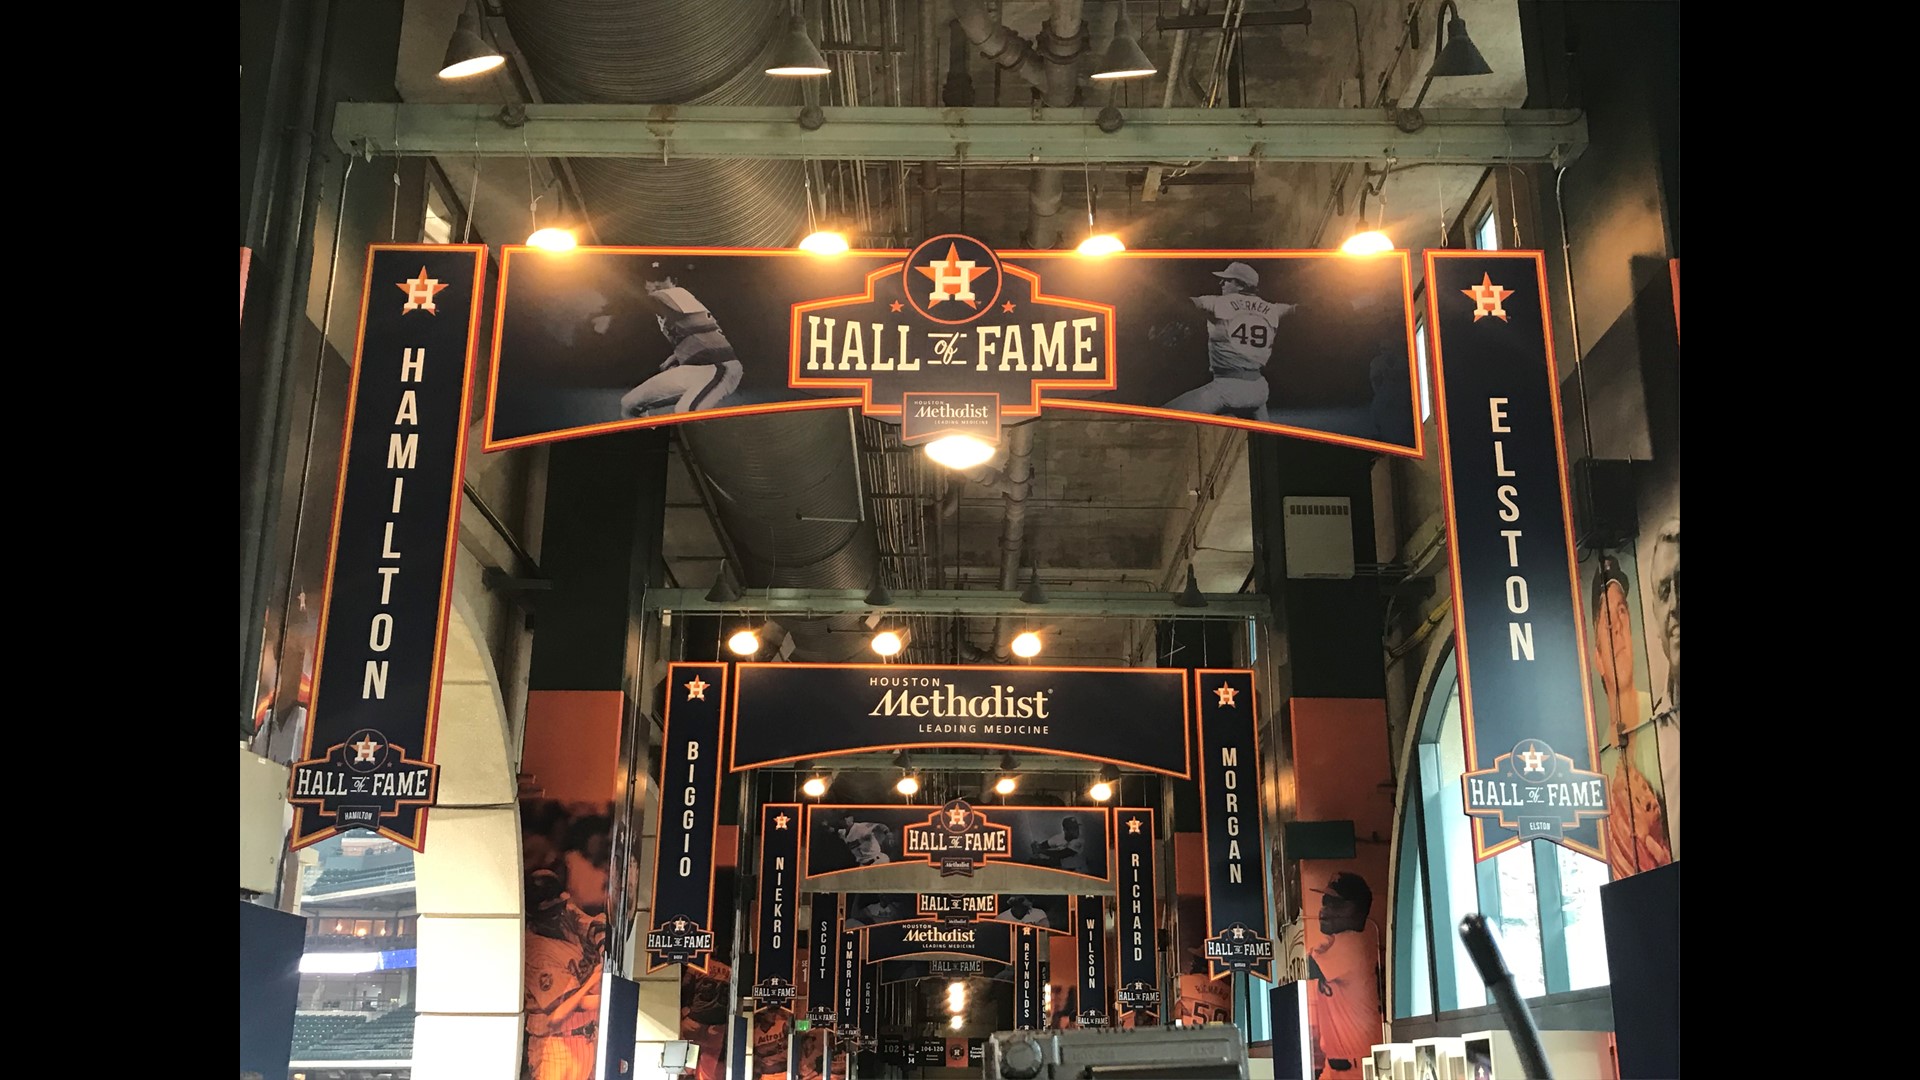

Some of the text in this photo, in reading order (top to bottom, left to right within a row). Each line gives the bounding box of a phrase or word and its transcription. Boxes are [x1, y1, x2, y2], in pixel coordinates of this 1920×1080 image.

[807, 315, 1098, 372] HALL of FAME
[1231, 323, 1268, 348] 49
[914, 403, 989, 418] Methodist
[362, 347, 426, 699] HAMILTON
[1489, 396, 1535, 661] ELSTON
[869, 677, 941, 687] HOUSTON
[868, 684, 1049, 719] Methodist
[918, 724, 1049, 735] LEADING MEDICINE
[296, 768, 429, 797] HALL of FAME
[1470, 778, 1604, 808] HALL of FAME
[344, 811, 373, 821] HAMILTON
[678, 741, 700, 878] BIGGIO
[1221, 747, 1243, 884] MORGAN
[1529, 821, 1551, 831] ELSTON
[909, 830, 948, 851] HALL
[965, 830, 1006, 851] FAME
[772, 856, 785, 949] NIEKRO
[921, 895, 950, 911] HALL
[963, 895, 994, 911] FAME
[1131, 853, 1142, 962] RICHARD
[647, 933, 673, 948] HALL
[683, 934, 711, 948] FAME
[902, 927, 976, 942] Methodist
[819, 921, 828, 979] SCOTT
[1086, 919, 1096, 989] WILSON
[1208, 941, 1233, 956] HALL
[1244, 942, 1271, 956] FAME
[932, 960, 952, 972] HALL
[960, 961, 981, 972] FAME
[845, 941, 853, 1017] UMBRICHT
[754, 987, 771, 997] HALL
[777, 987, 796, 997] FAME
[1119, 991, 1136, 1001] HALL
[1142, 992, 1160, 1001] FAME
[1077, 1016, 1090, 1024] HALL
[1094, 1016, 1108, 1024] FAME
[884, 1045, 900, 1053] 102
